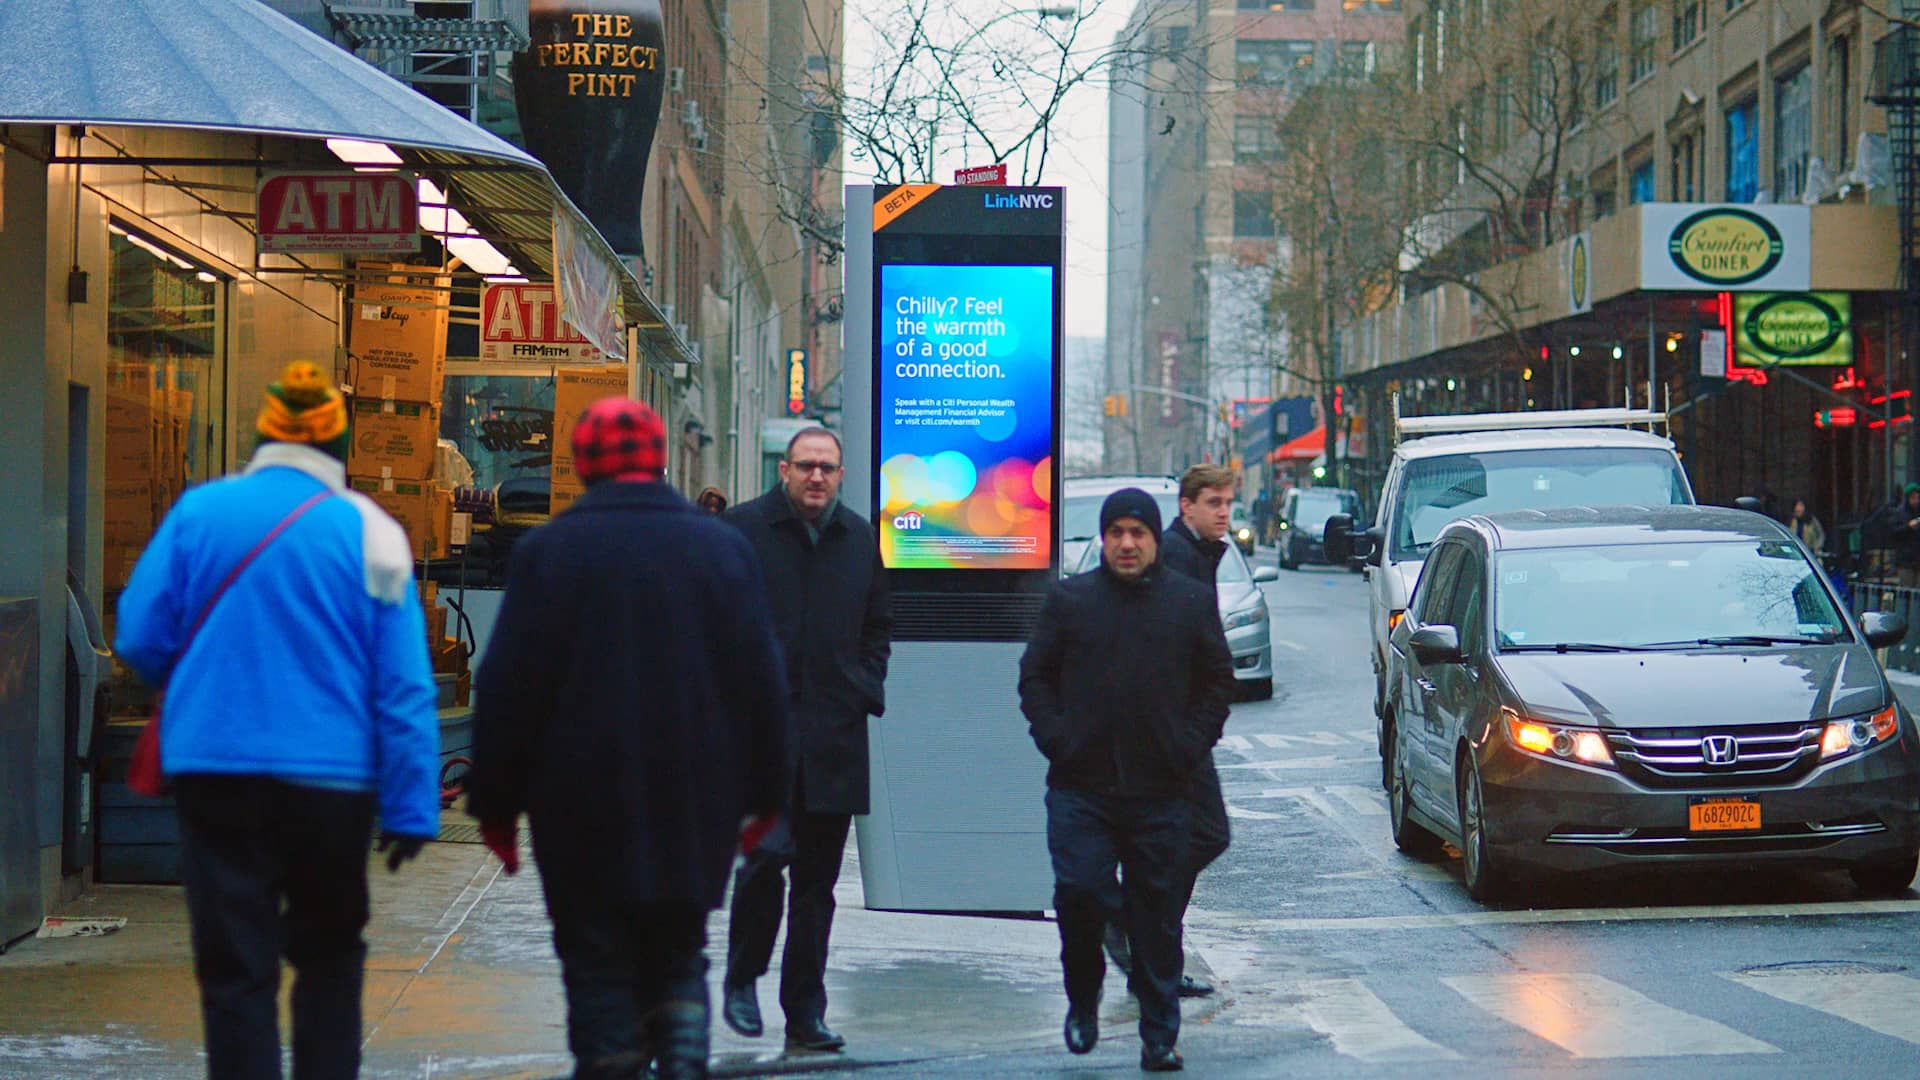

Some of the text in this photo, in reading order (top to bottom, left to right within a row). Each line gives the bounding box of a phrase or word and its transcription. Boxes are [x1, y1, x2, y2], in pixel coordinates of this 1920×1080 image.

[571, 13, 633, 37] THE
[537, 42, 658, 70] PERFECT
[567, 73, 637, 97] PINT
[957, 169, 999, 184] NO STANDING
[275, 180, 401, 231] ATM
[884, 189, 916, 214] BETA
[984, 193, 1053, 209] LinkNYC
[1684, 227, 1766, 253] Comfort
[1701, 254, 1750, 270] DINER
[895, 296, 1003, 318] Chilly? Feel
[895, 317, 1006, 336] the warmth
[895, 338, 987, 361] of a good
[895, 360, 1006, 378] connection.
[895, 398, 917, 407] Speak
[918, 398, 935, 406] with
[942, 398, 955, 406] Citi
[990, 399, 1015, 407] Wealth
[895, 408, 1006, 417] Management Financial Advisor
[893, 511, 921, 530] citi
[1696, 804, 1755, 824] T682902C
